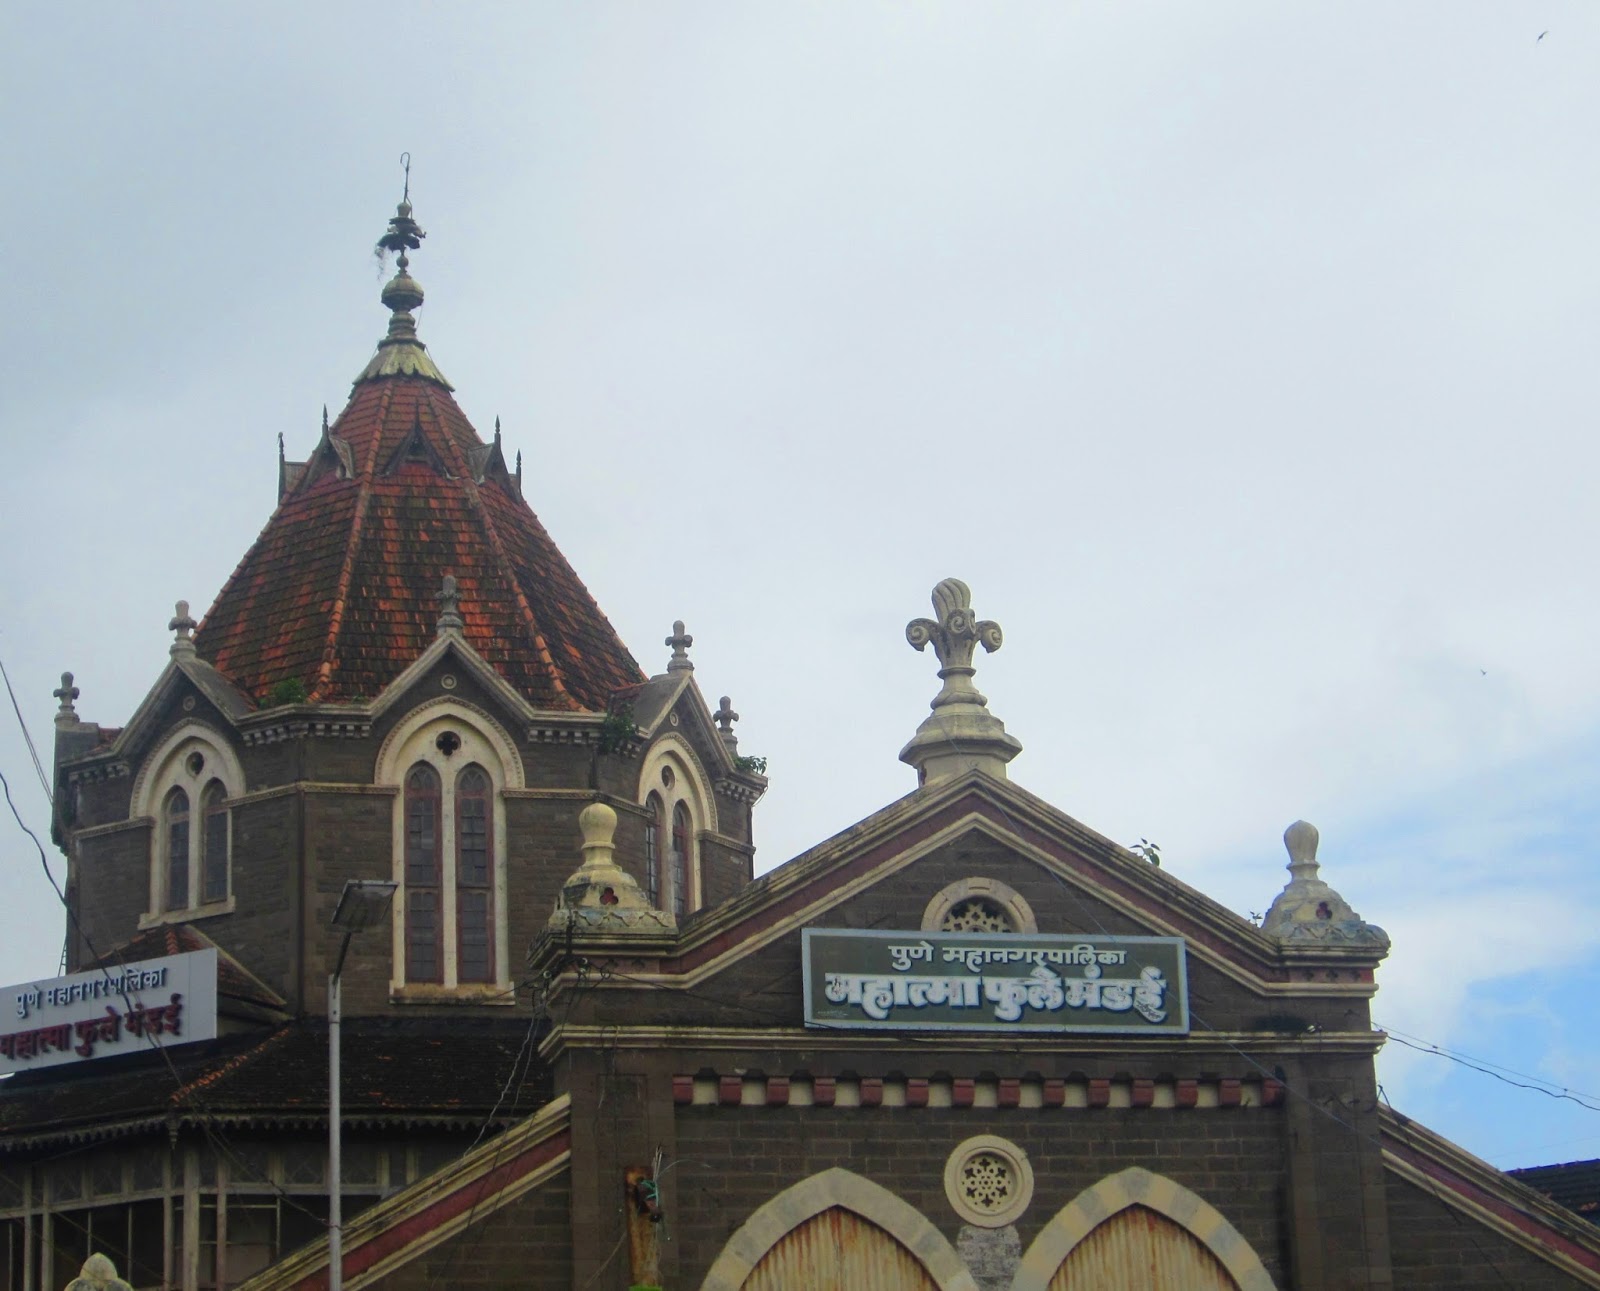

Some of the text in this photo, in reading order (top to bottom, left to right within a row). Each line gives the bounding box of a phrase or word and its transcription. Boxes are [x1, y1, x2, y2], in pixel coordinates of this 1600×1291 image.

[888, 940, 1127, 973] पुणे महानगरपालिका
[16, 967, 167, 1018] पुणे महानगरपालिका
[825, 964, 1167, 1022] महात्मा फुले मंडई
[74, 1005, 122, 1057] फुले
[124, 993, 183, 1037] मंडई
